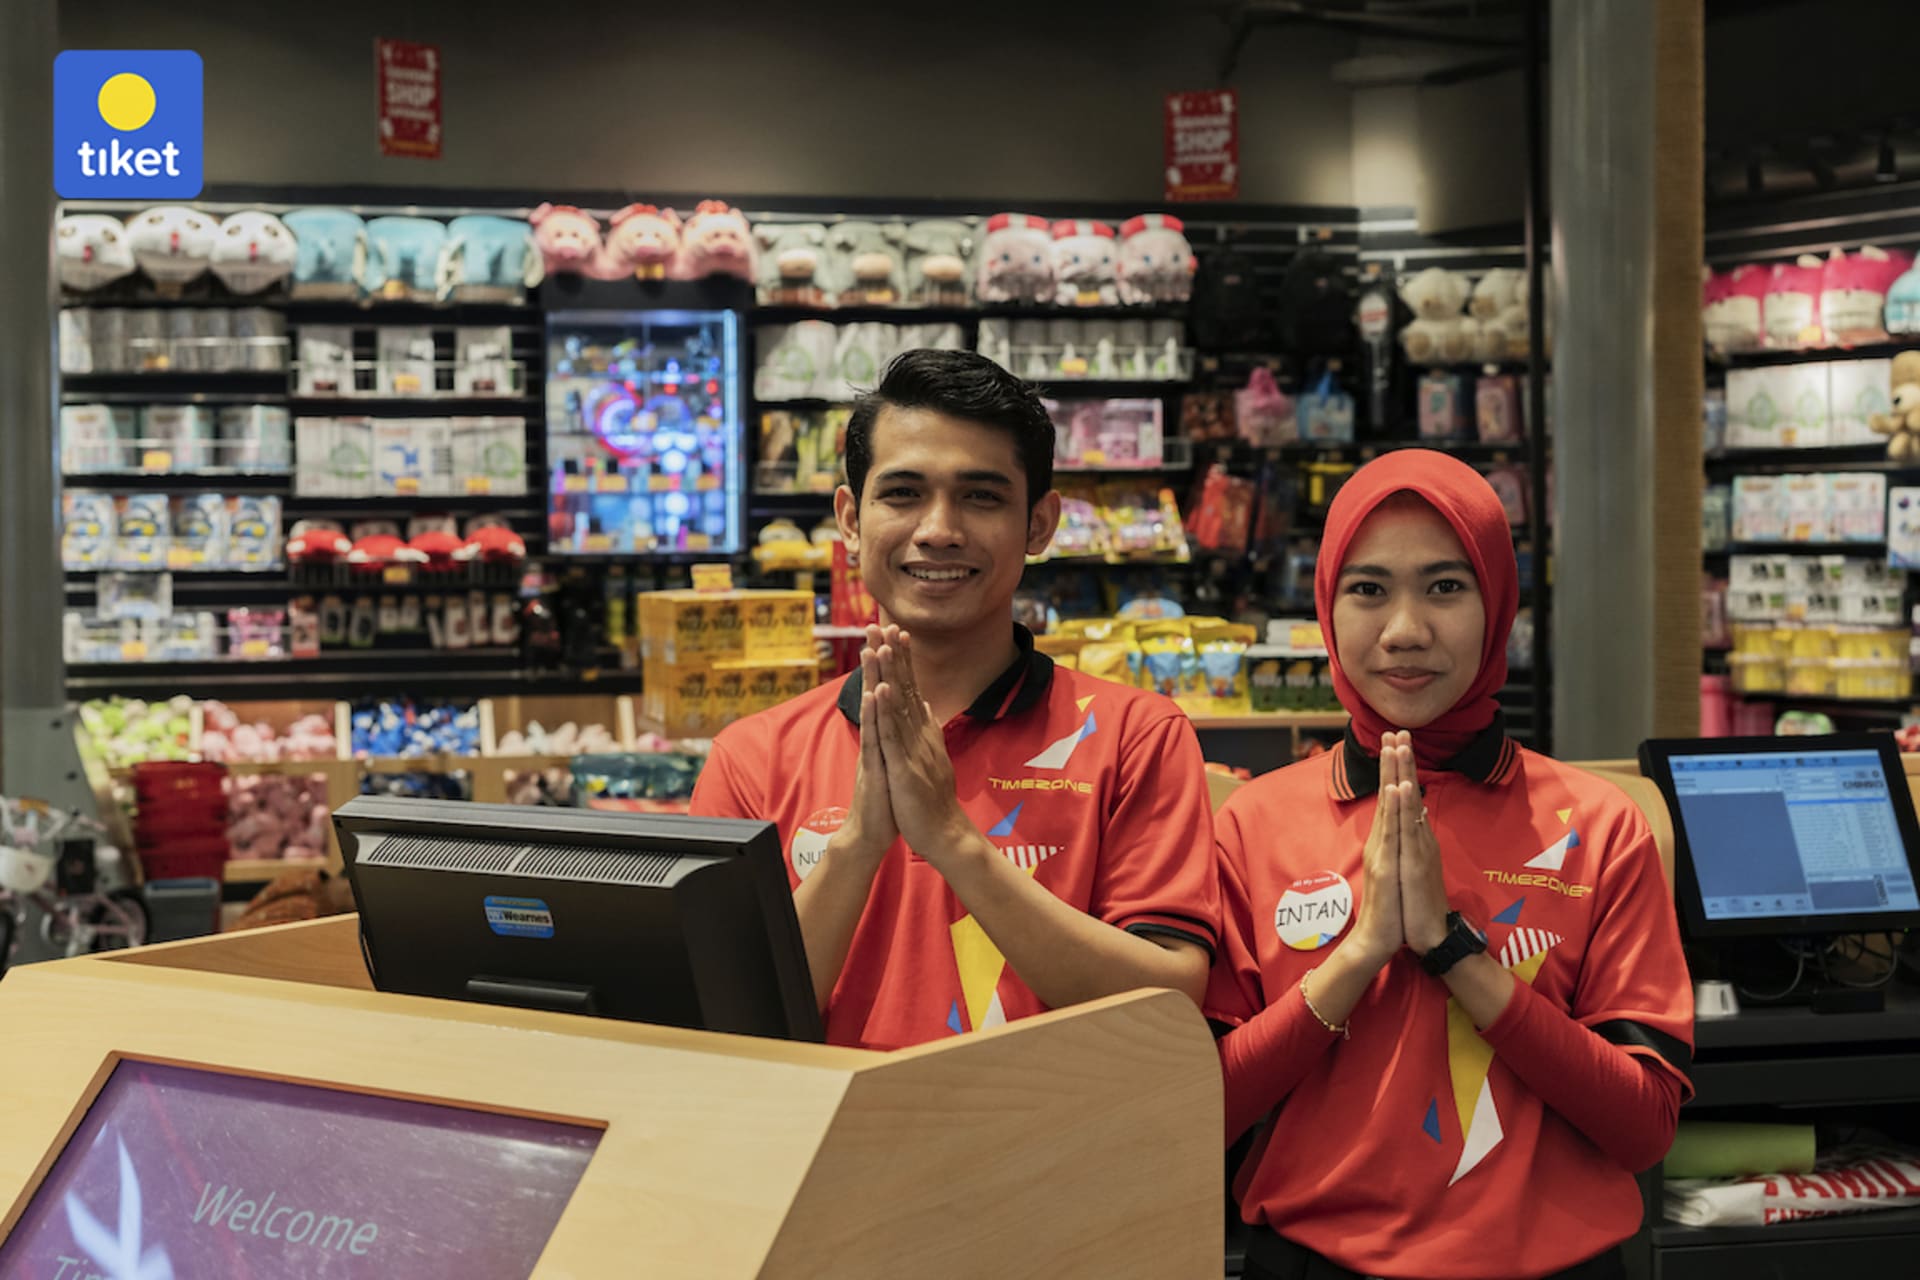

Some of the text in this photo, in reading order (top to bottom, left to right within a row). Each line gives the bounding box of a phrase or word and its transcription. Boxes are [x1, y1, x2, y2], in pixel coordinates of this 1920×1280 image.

[1175, 129, 1230, 152] SHOP
[988, 777, 1093, 794] TIMEZONE
[1483, 869, 1585, 897] TIMEZONE
[503, 909, 551, 925] Wearnes
[1276, 896, 1348, 928] INTAN
[1742, 1160, 1920, 1198] FAMIL
[193, 1182, 379, 1256] Welcome
